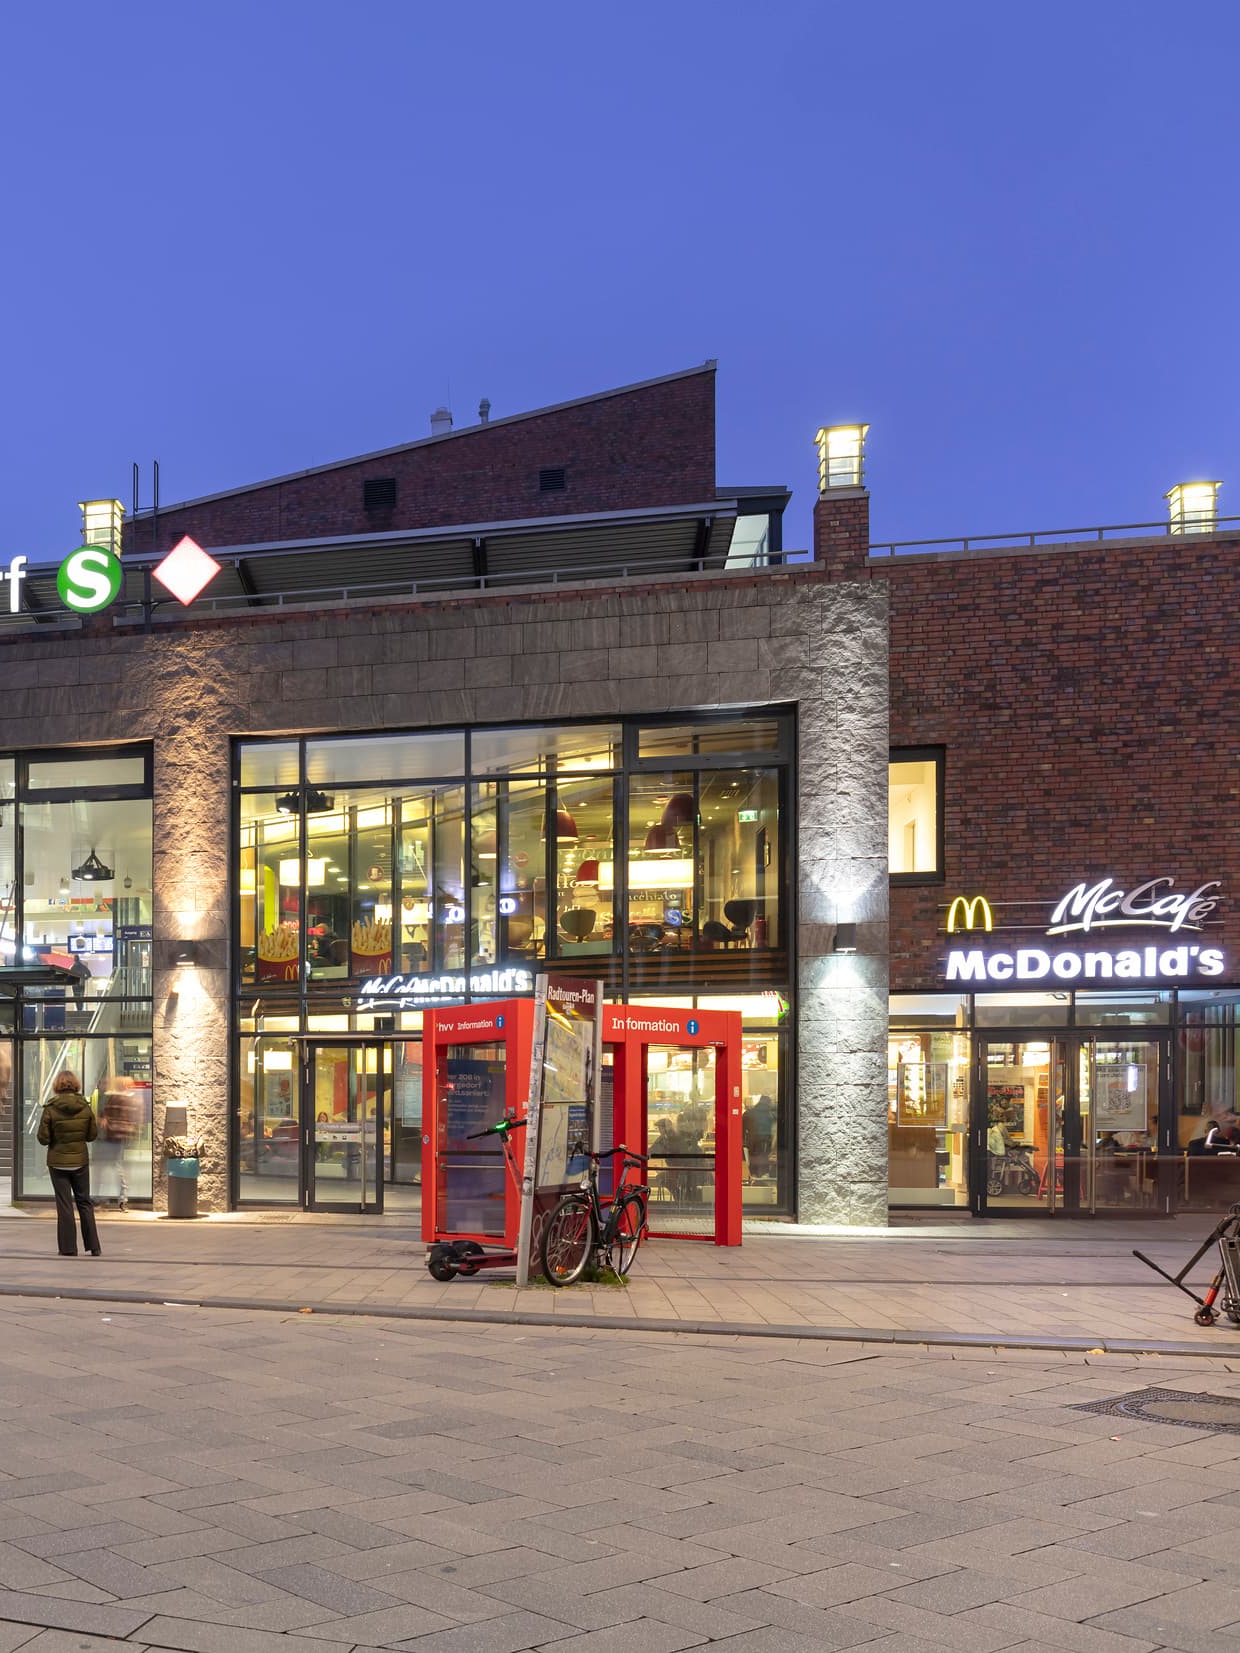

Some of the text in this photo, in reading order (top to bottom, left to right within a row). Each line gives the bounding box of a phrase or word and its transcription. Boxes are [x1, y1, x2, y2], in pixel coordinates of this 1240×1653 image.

[65, 549, 112, 608] S
[1050, 877, 1222, 932] McCafé
[946, 946, 1225, 980] McDonald's
[548, 985, 595, 1004] Radtouren-Plan
[457, 1018, 493, 1031] Information
[611, 1017, 679, 1033] Information
